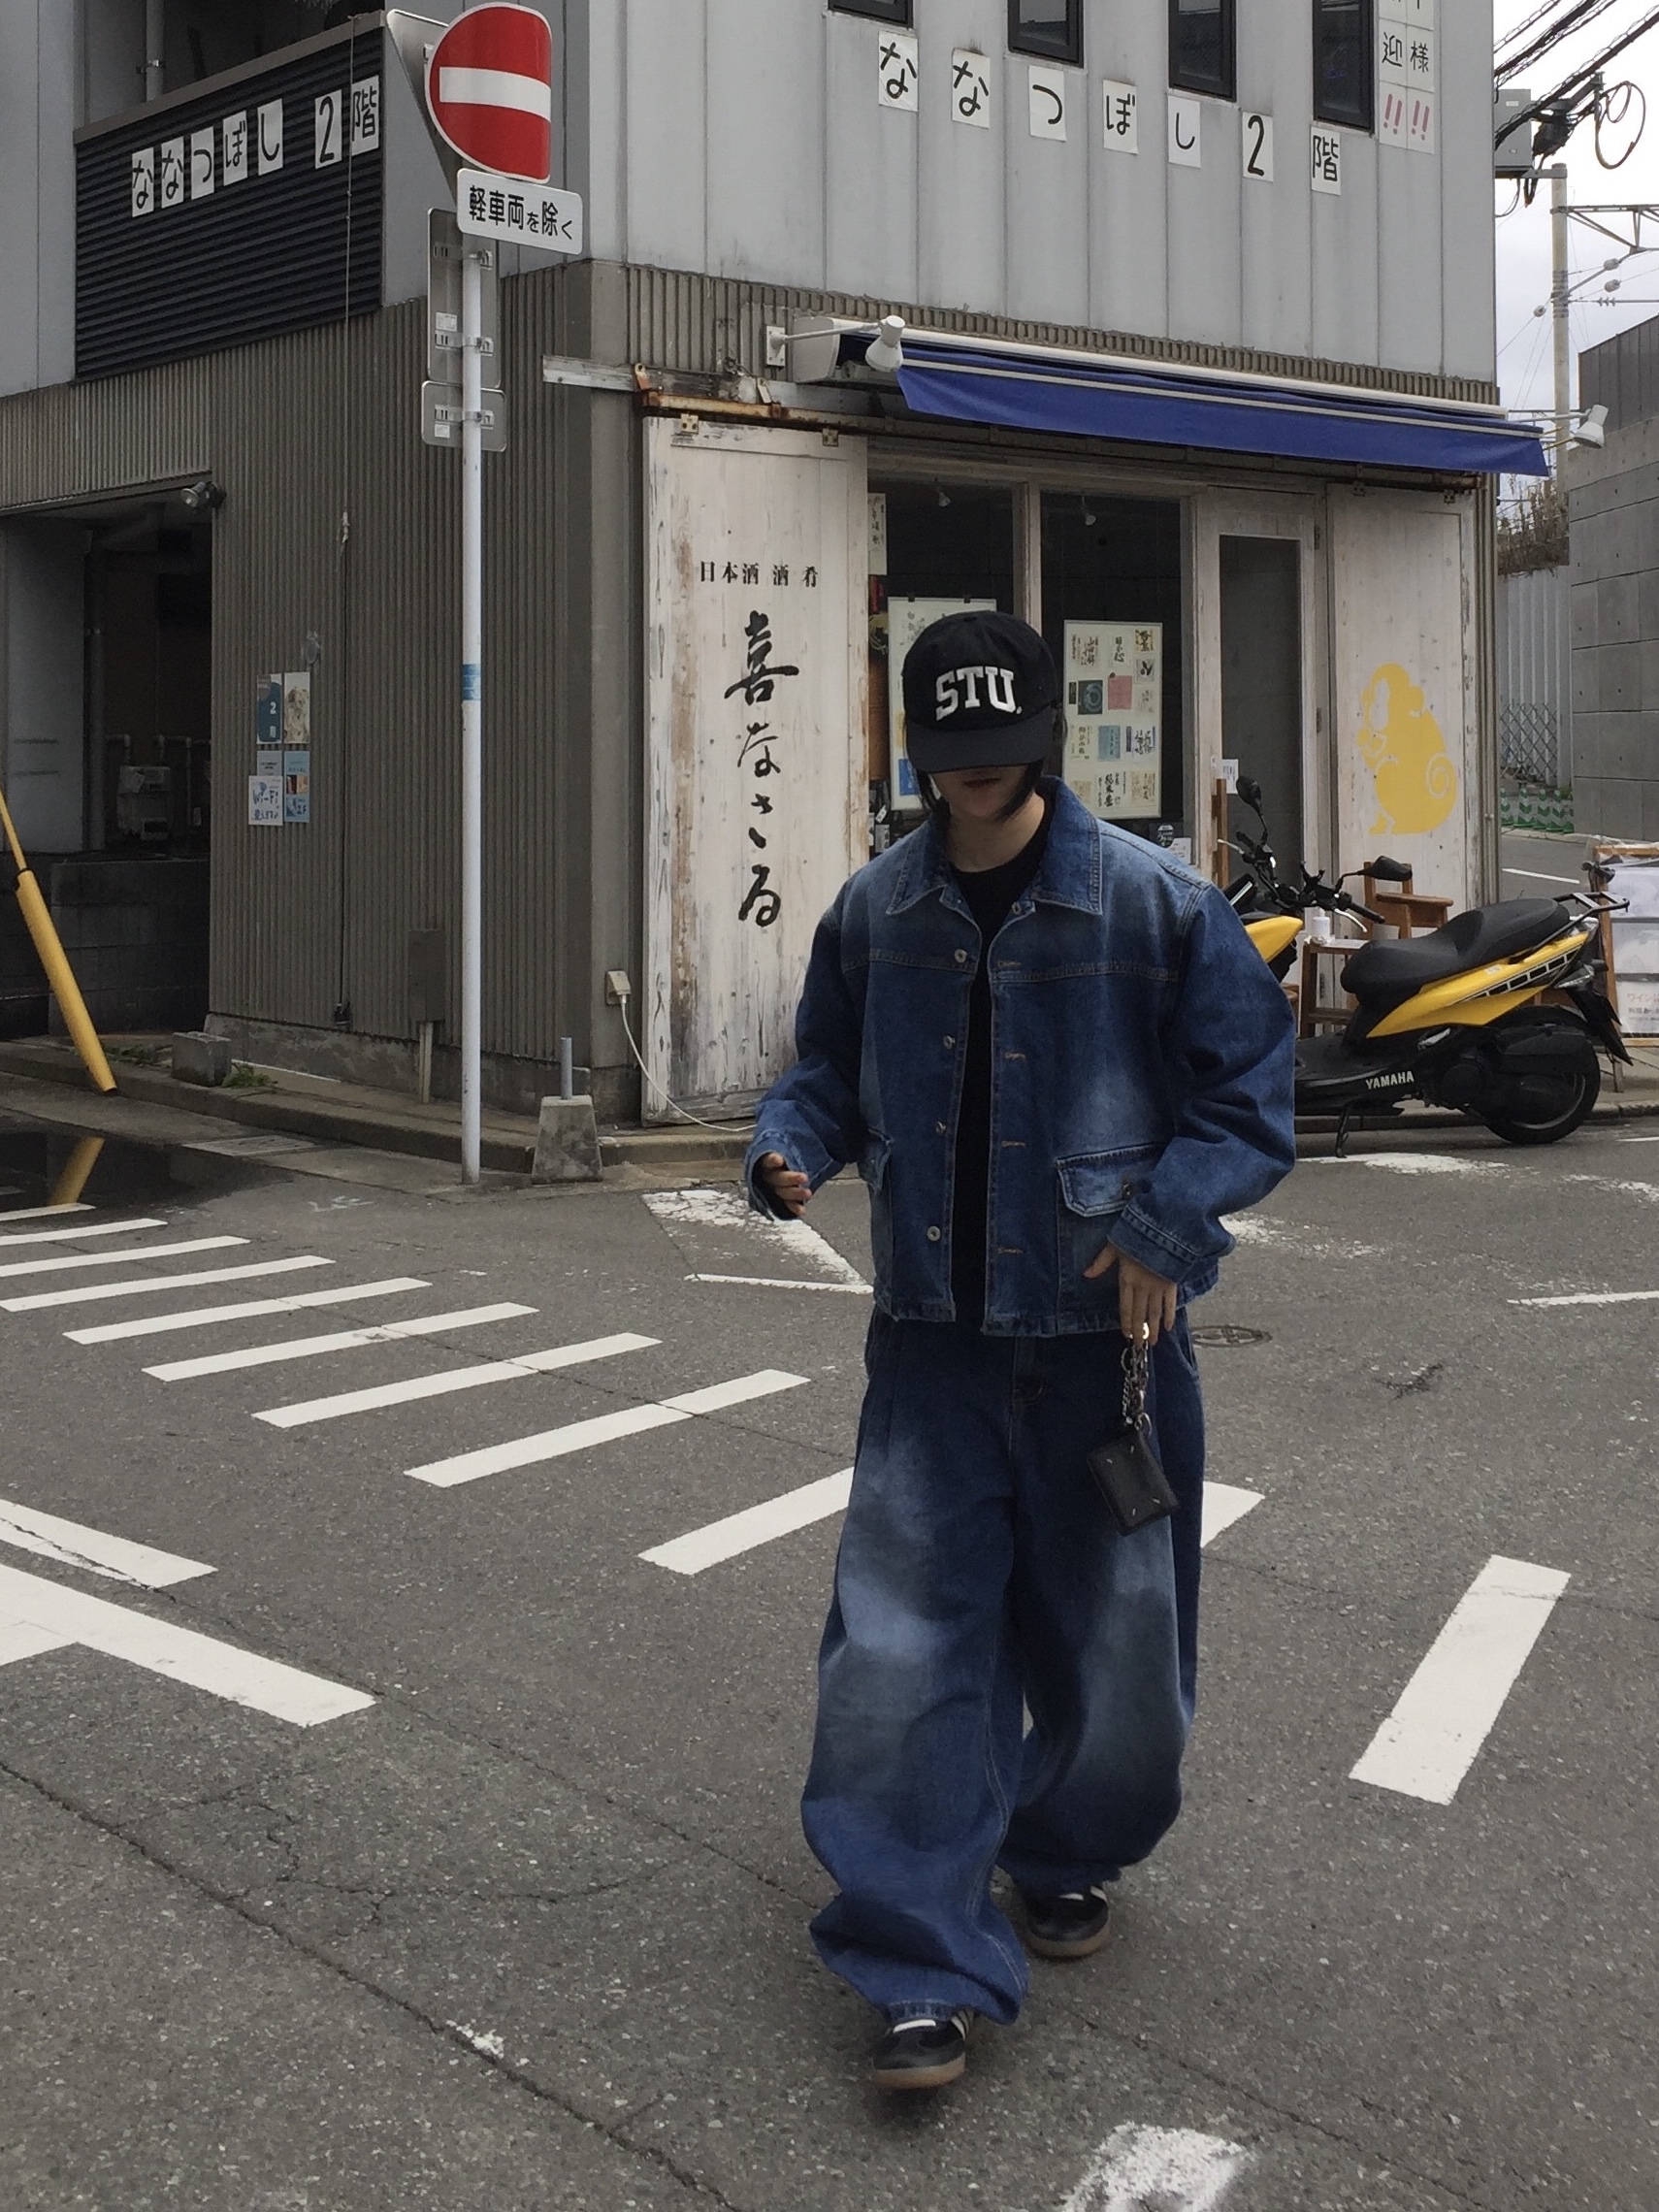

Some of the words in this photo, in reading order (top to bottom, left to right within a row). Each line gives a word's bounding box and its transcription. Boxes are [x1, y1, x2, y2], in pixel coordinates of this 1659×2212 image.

[469, 184, 572, 241] 軽車両を除く
[700, 561, 759, 585] 日本酒
[1365, 1070, 1415, 1090] YAMAHA
